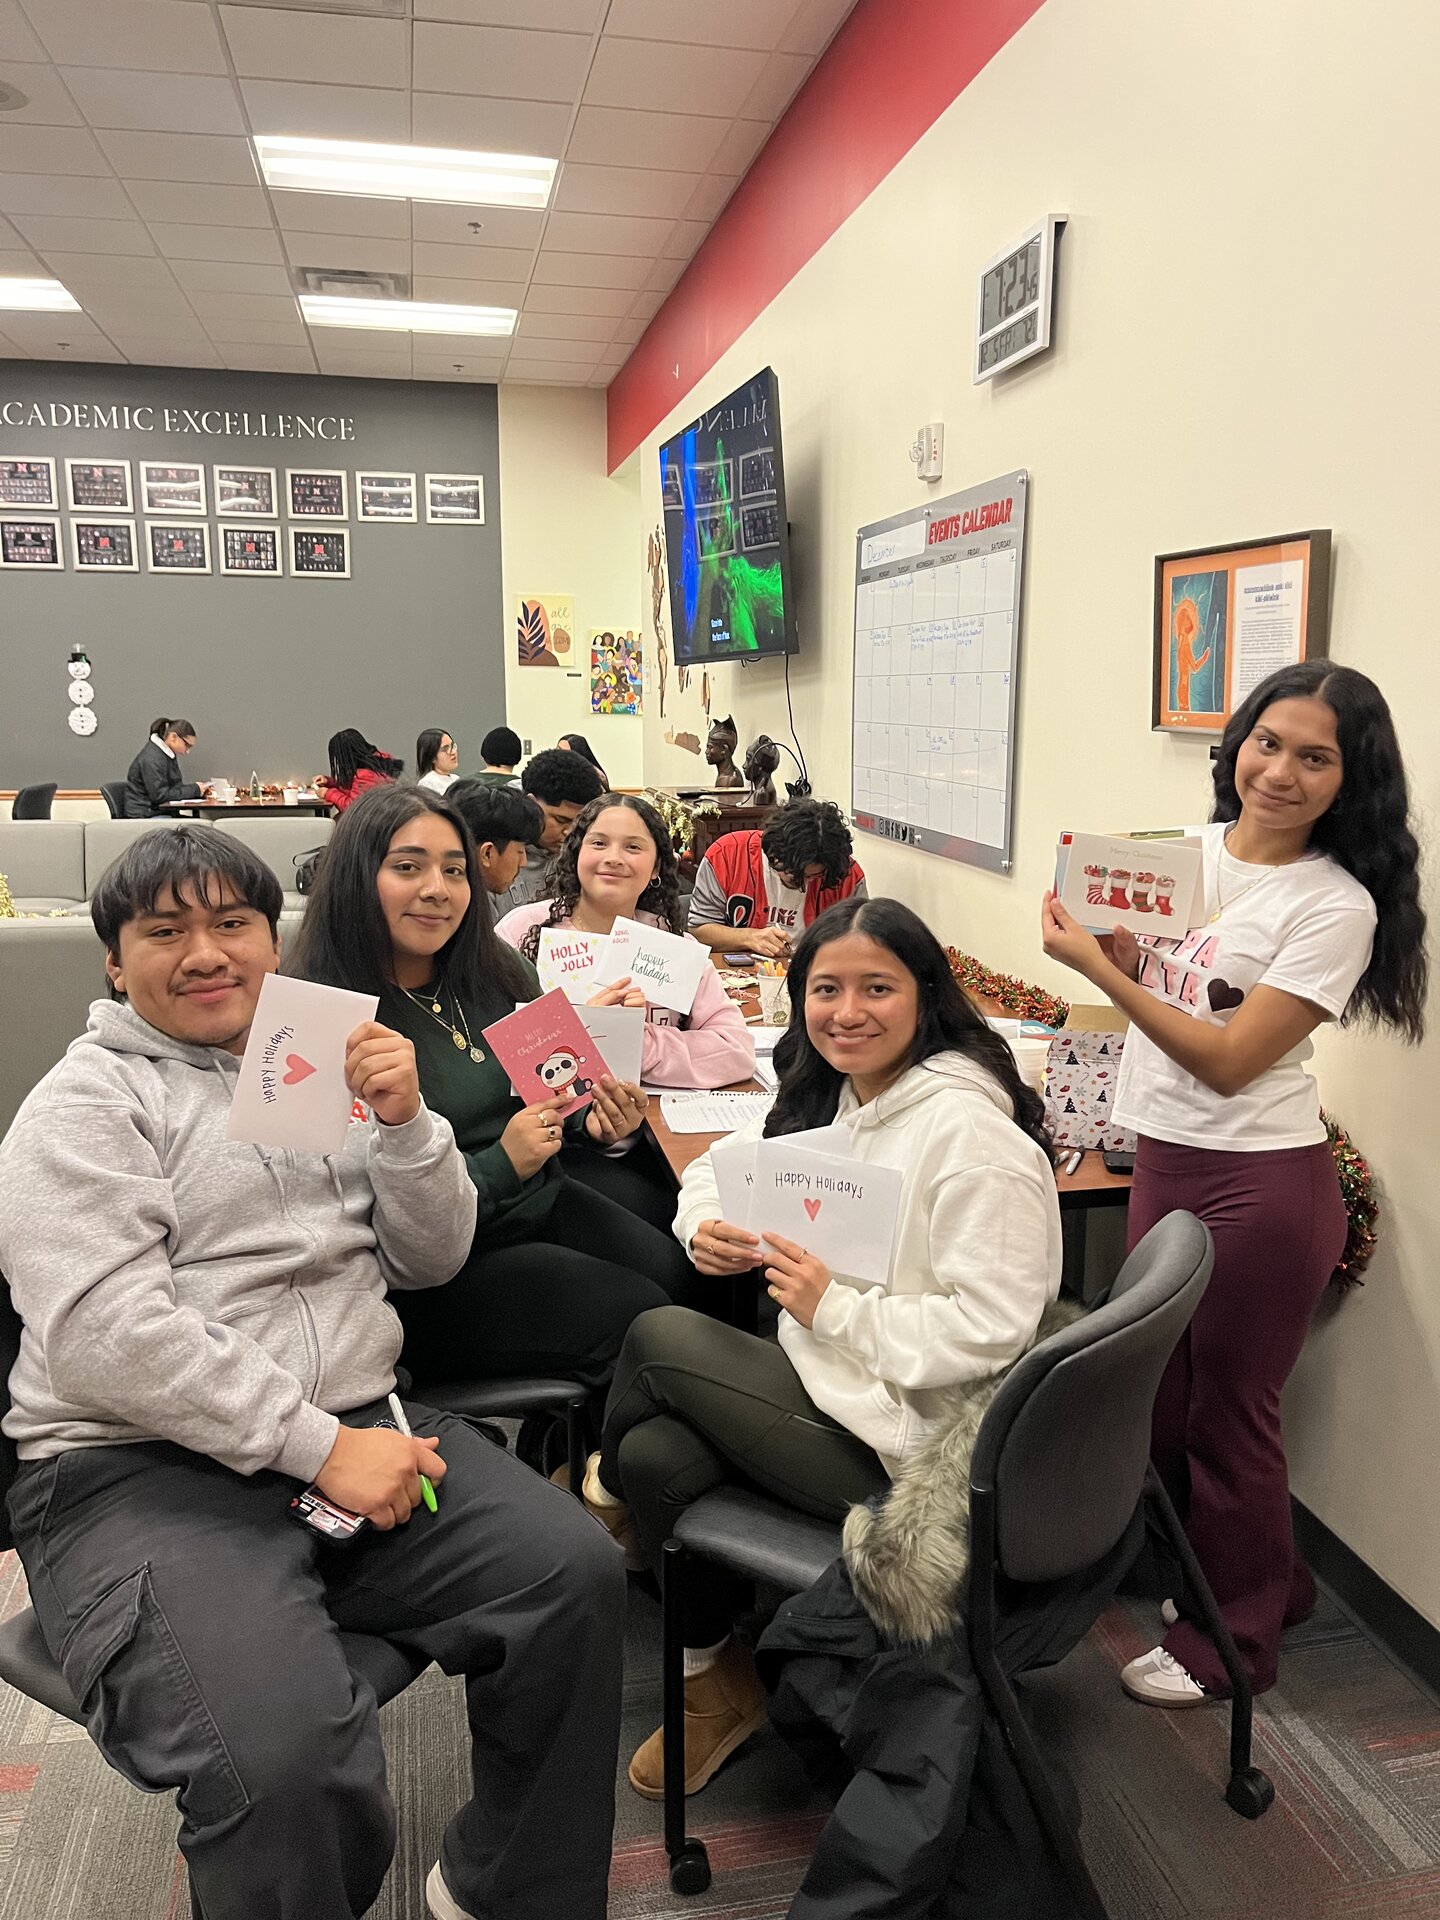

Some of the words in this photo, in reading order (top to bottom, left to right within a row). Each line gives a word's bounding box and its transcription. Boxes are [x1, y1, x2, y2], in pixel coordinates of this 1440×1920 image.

[163, 408, 356, 441] EXCELLENCE
[928, 514, 960, 545] EVENTS
[962, 498, 1013, 536] CALENDAR
[768, 906, 798, 926] IKE
[550, 942, 589, 961] HOLLY
[561, 956, 594, 972] JOLLY
[637, 947, 670, 970] happy
[630, 958, 675, 986] holidays
[1139, 953, 1199, 1006] LTA
[775, 1171, 811, 1189] Happy
[816, 1175, 864, 1199] Holidays
